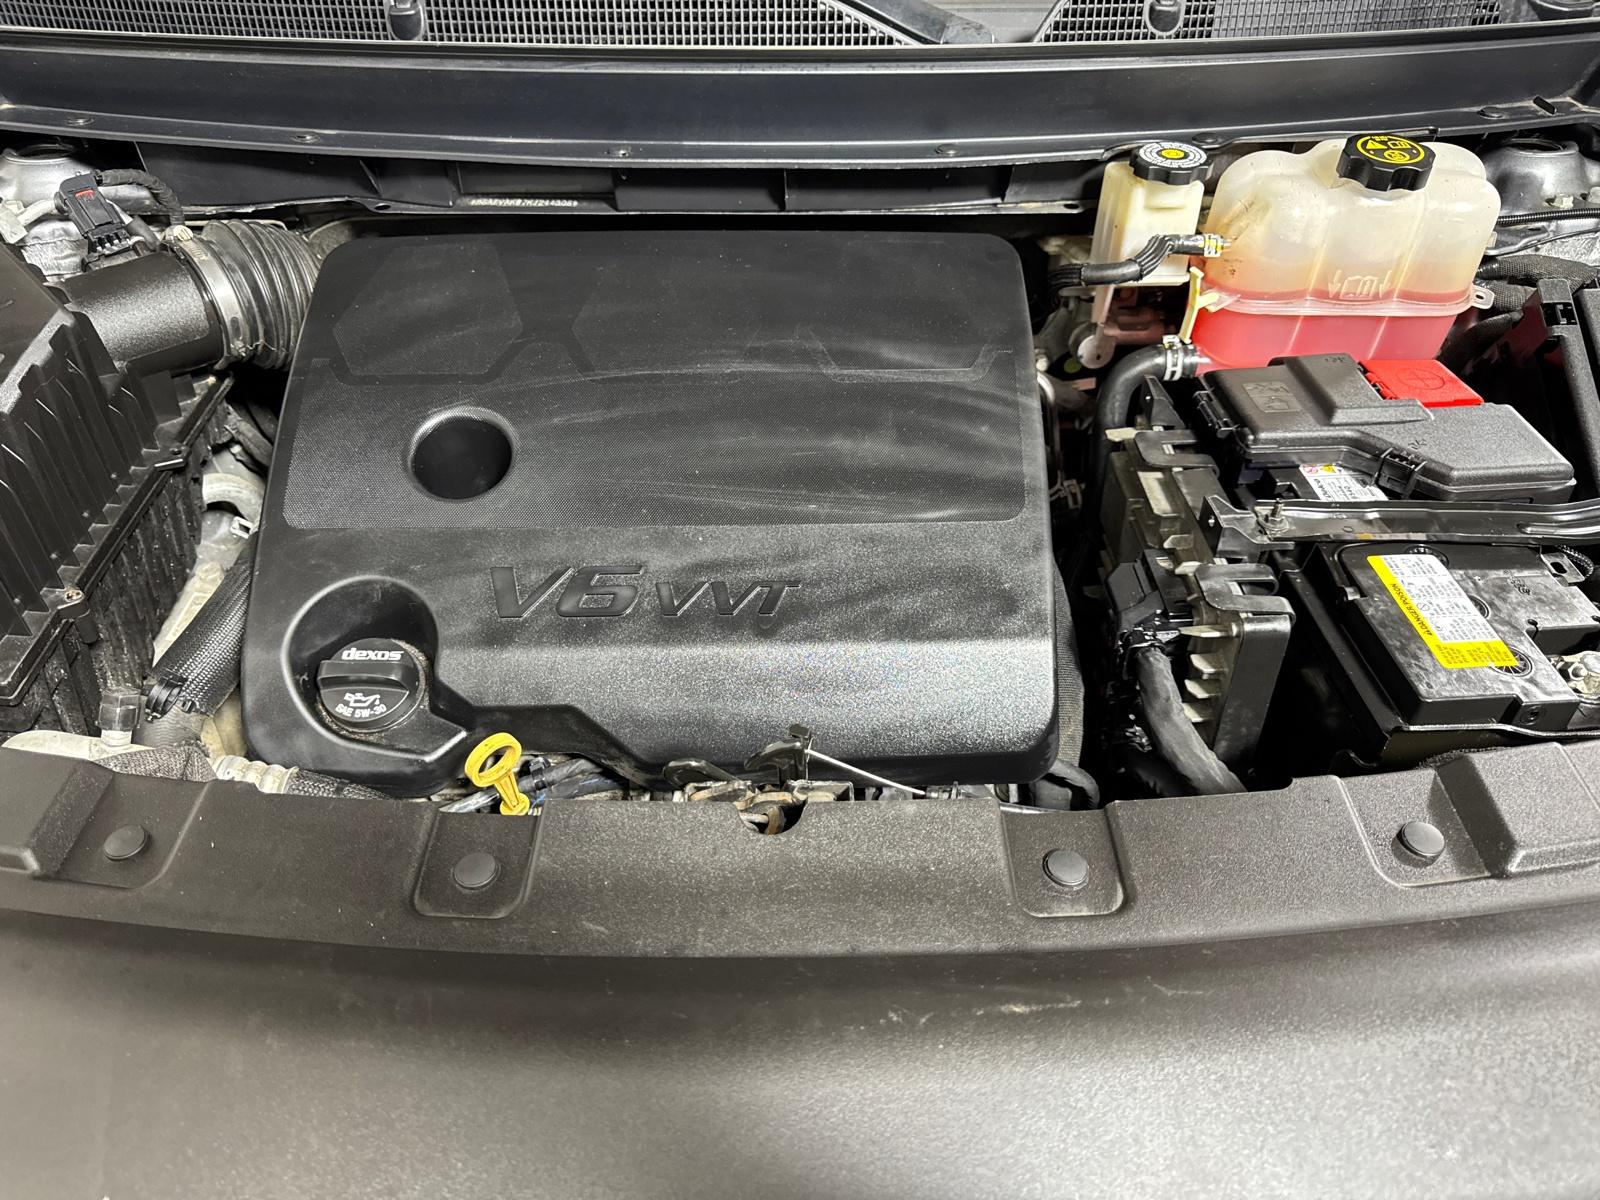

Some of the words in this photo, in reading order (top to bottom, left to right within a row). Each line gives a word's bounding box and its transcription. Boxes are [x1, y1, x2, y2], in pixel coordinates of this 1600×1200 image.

[491, 567, 643, 618] V6
[655, 581, 801, 616] VVT
[1389, 583, 1410, 605] POISON
[1405, 606, 1427, 629] DANGER
[341, 647, 404, 661] dexos
[335, 703, 353, 717] SAE
[354, 703, 387, 718] 5W-30
